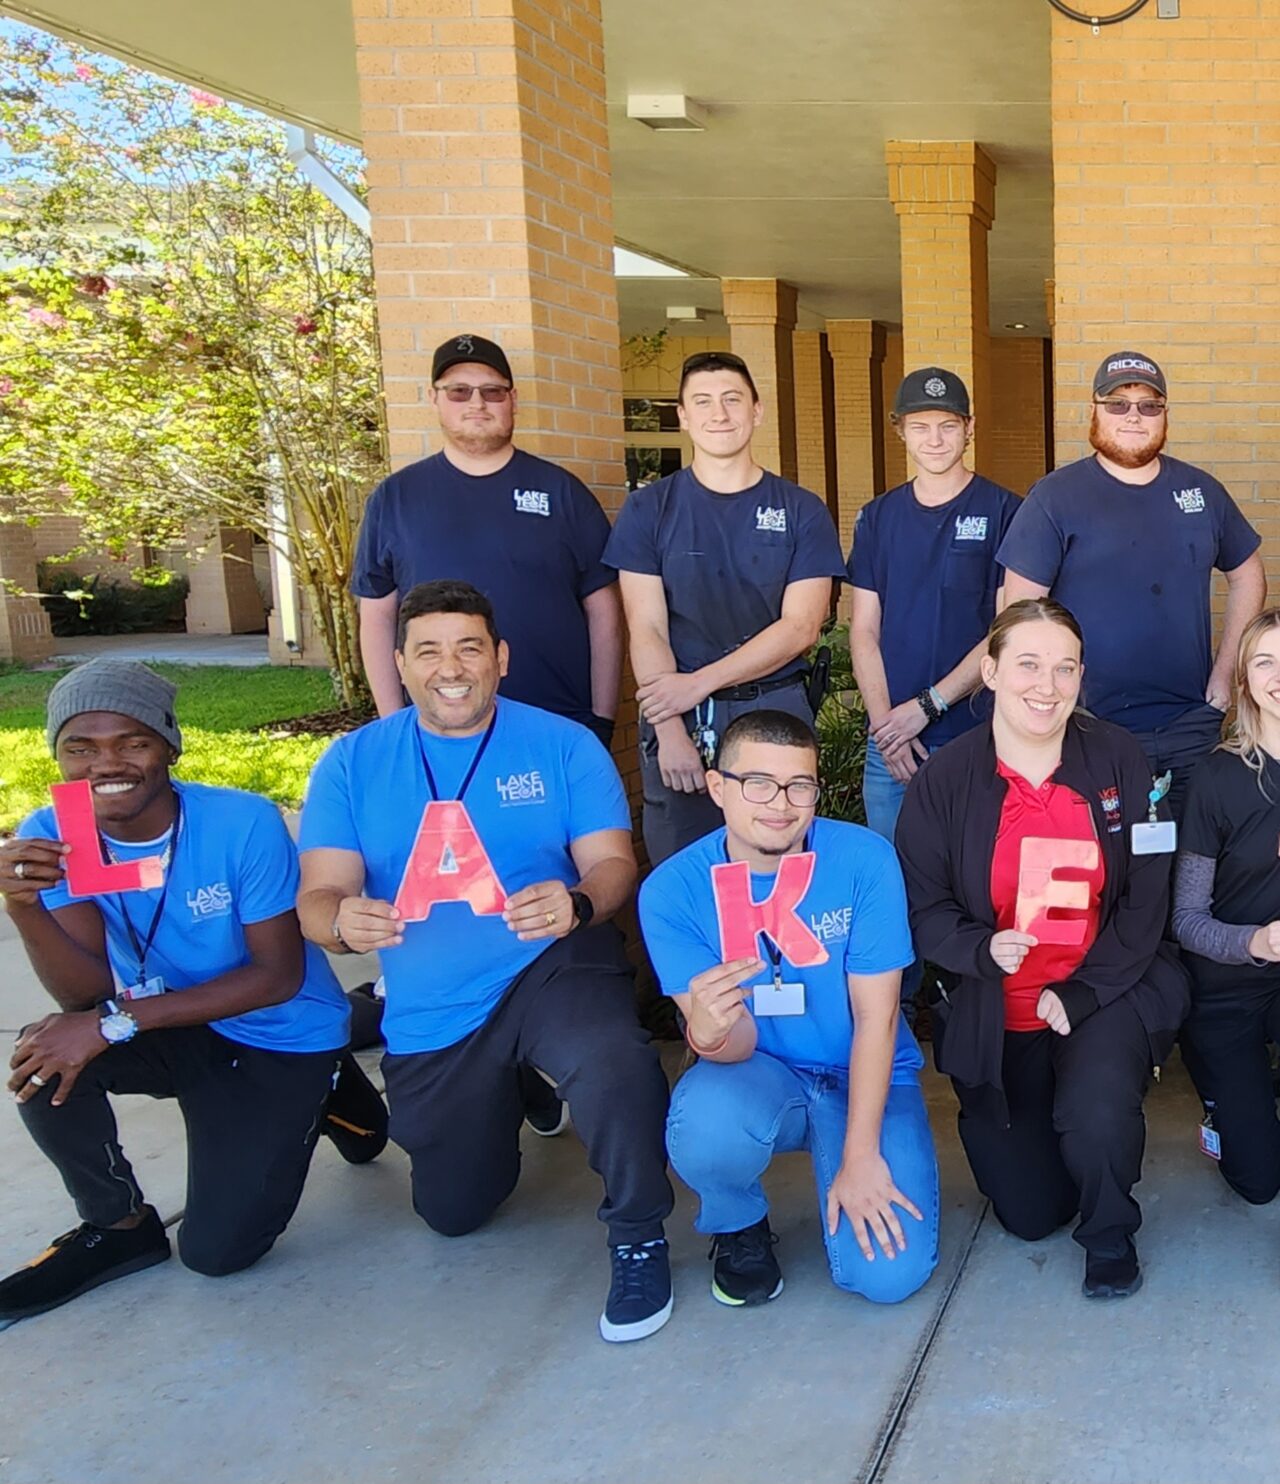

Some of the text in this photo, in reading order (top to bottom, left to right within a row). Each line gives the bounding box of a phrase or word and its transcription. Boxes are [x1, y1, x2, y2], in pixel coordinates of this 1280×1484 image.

[1107, 359, 1157, 375] RIDGID
[514, 488, 549, 501] LAKE
[1172, 487, 1202, 503] LAKE
[516, 498, 549, 512] TECH
[1178, 495, 1205, 510] TECH
[756, 506, 786, 519] LAKE
[757, 514, 787, 528] TECH
[955, 515, 988, 528] LAKE
[956, 523, 987, 536] TECH
[496, 770, 541, 792] LAKE
[499, 780, 545, 801] TECH
[49, 779, 164, 898] L
[394, 799, 509, 922] A
[710, 851, 830, 968] K
[1014, 836, 1099, 946] E
[187, 882, 228, 907] LAKE
[811, 907, 853, 931] LAKE
